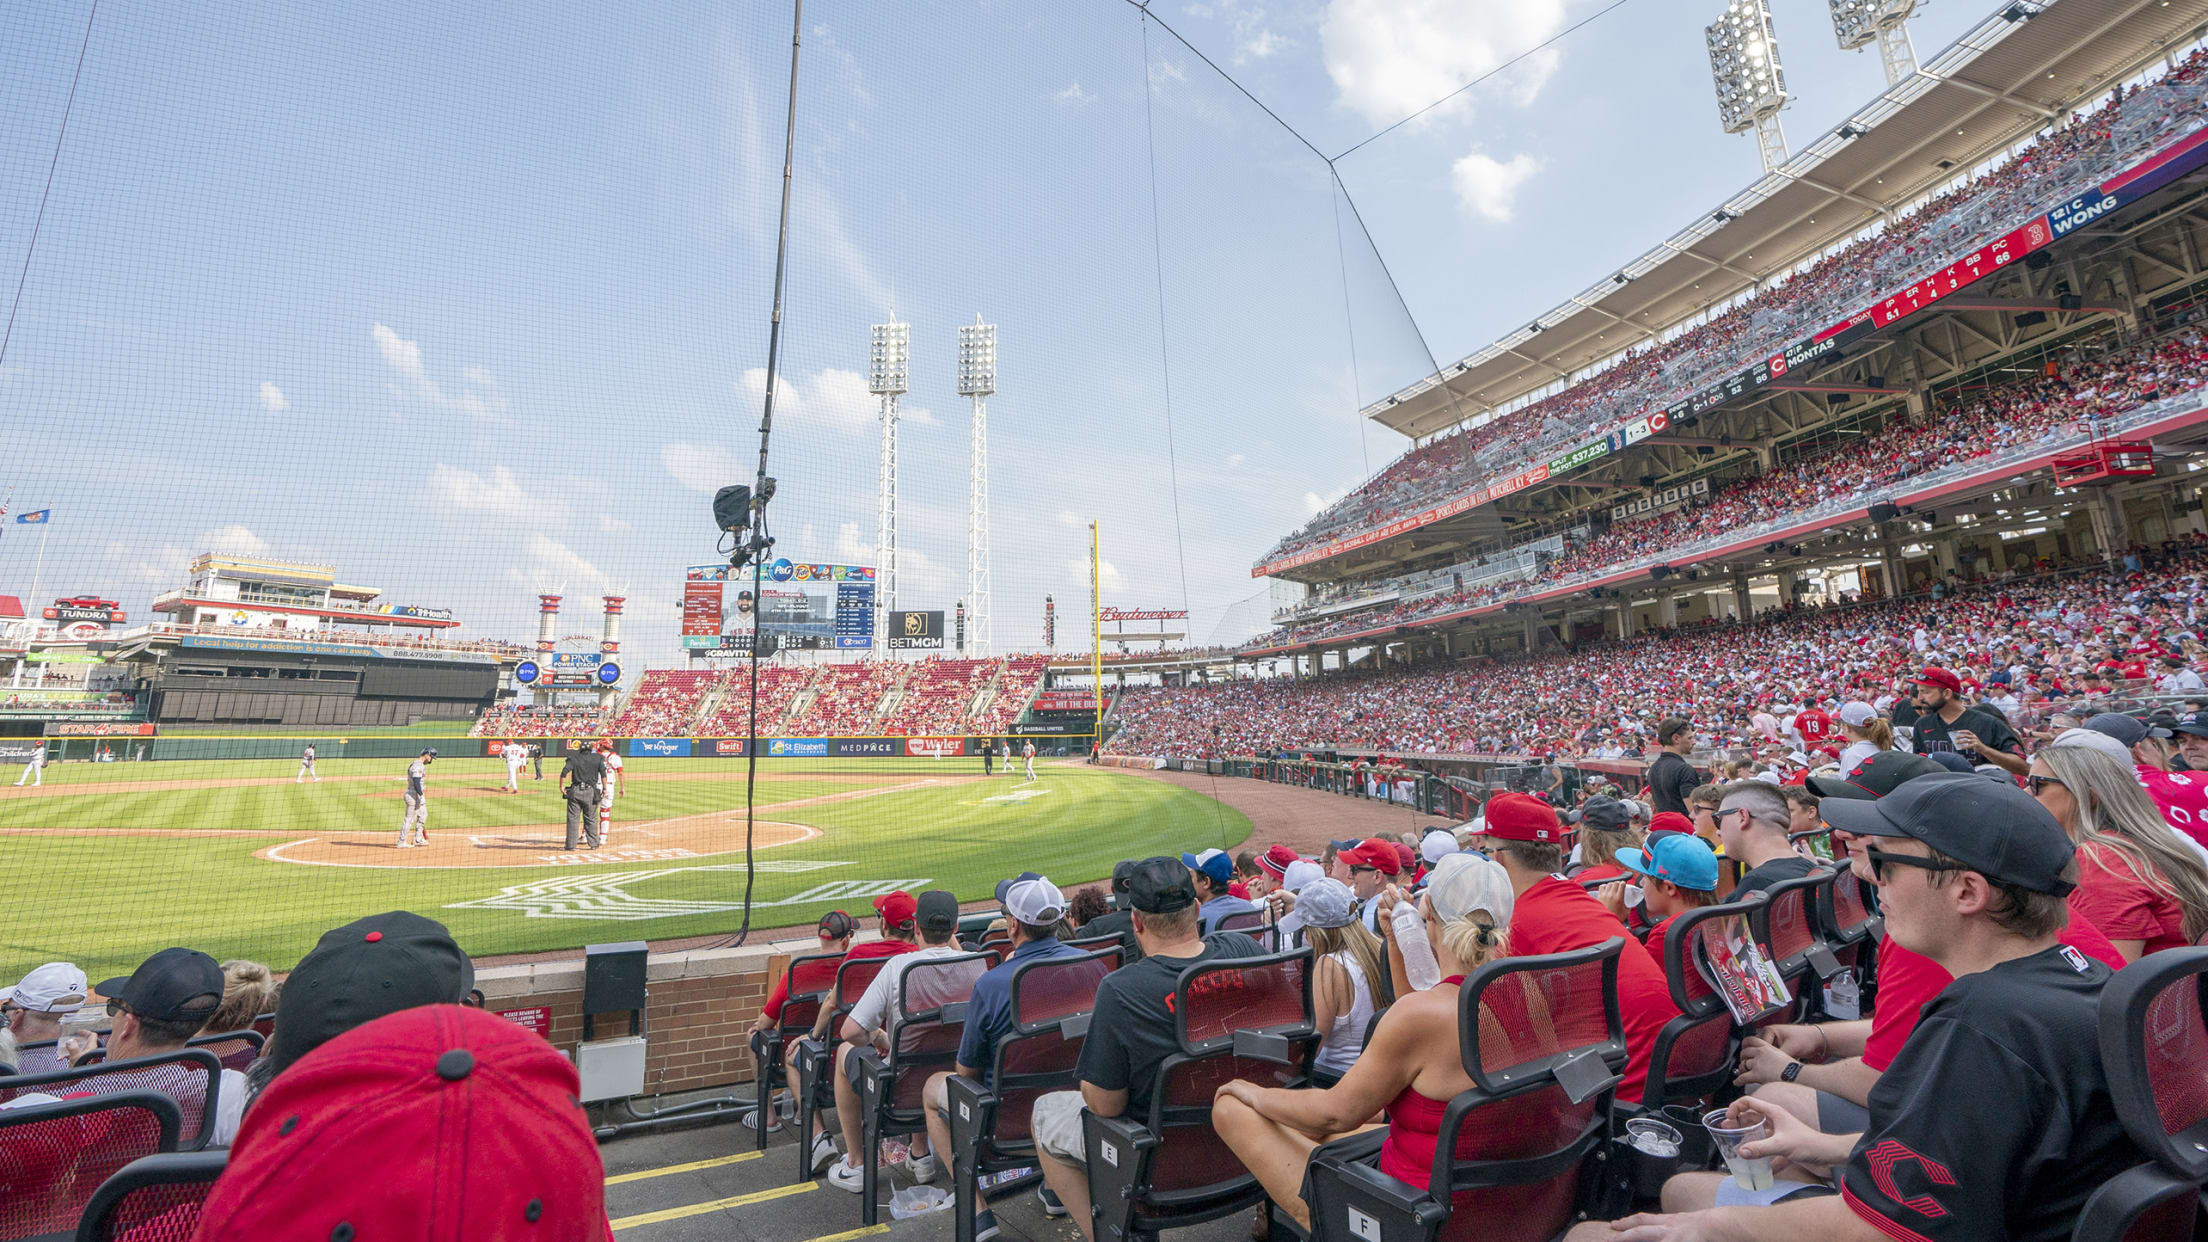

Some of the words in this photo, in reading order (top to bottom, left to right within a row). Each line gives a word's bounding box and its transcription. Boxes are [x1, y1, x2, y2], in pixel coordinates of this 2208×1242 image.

[2054, 196, 2118, 234] WONG
[1886, 299, 1895, 308] IP
[1906, 286, 1919, 298] ER
[1926, 278, 1935, 287] H
[1947, 266, 1955, 276] K
[1966, 254, 1982, 266] BB
[1992, 240, 2008, 252] PC
[1886, 308, 1900, 321] 5.1
[1911, 298, 1918, 308] 1
[1930, 288, 1938, 298] 4
[1950, 278, 1958, 289] 3
[1972, 266, 1980, 276] 1
[1996, 252, 2010, 265] 66
[1848, 310, 1872, 325] TODAY
[1788, 338, 1835, 368] MONTAS
[1756, 373, 1768, 384] 86
[1731, 385, 1742, 395] 52
[1668, 400, 1688, 413] INNING
[1572, 442, 1607, 464] $37,230
[1552, 457, 1567, 468] SPLIT
[1550, 466, 1561, 475] THE
[1561, 462, 1572, 471] POT
[1516, 475, 1524, 486] KY
[775, 566, 792, 576] P&G
[796, 568, 809, 577] Tide
[62, 610, 108, 620] TUNDRA
[417, 608, 452, 619] TriHealth
[1100, 607, 1188, 622] Budweiser
[222, 640, 244, 649] help
[261, 642, 304, 650] addiction
[333, 645, 348, 654] call
[890, 638, 942, 648] BETMGM
[59, 724, 95, 734] STAR
[1806, 720, 1819, 732] 19
[654, 741, 678, 755] Kroger
[719, 742, 740, 750] Swift
[841, 743, 892, 752] MEDPACE
[925, 739, 961, 750] Wyler
[1361, 1218, 1368, 1233] F
